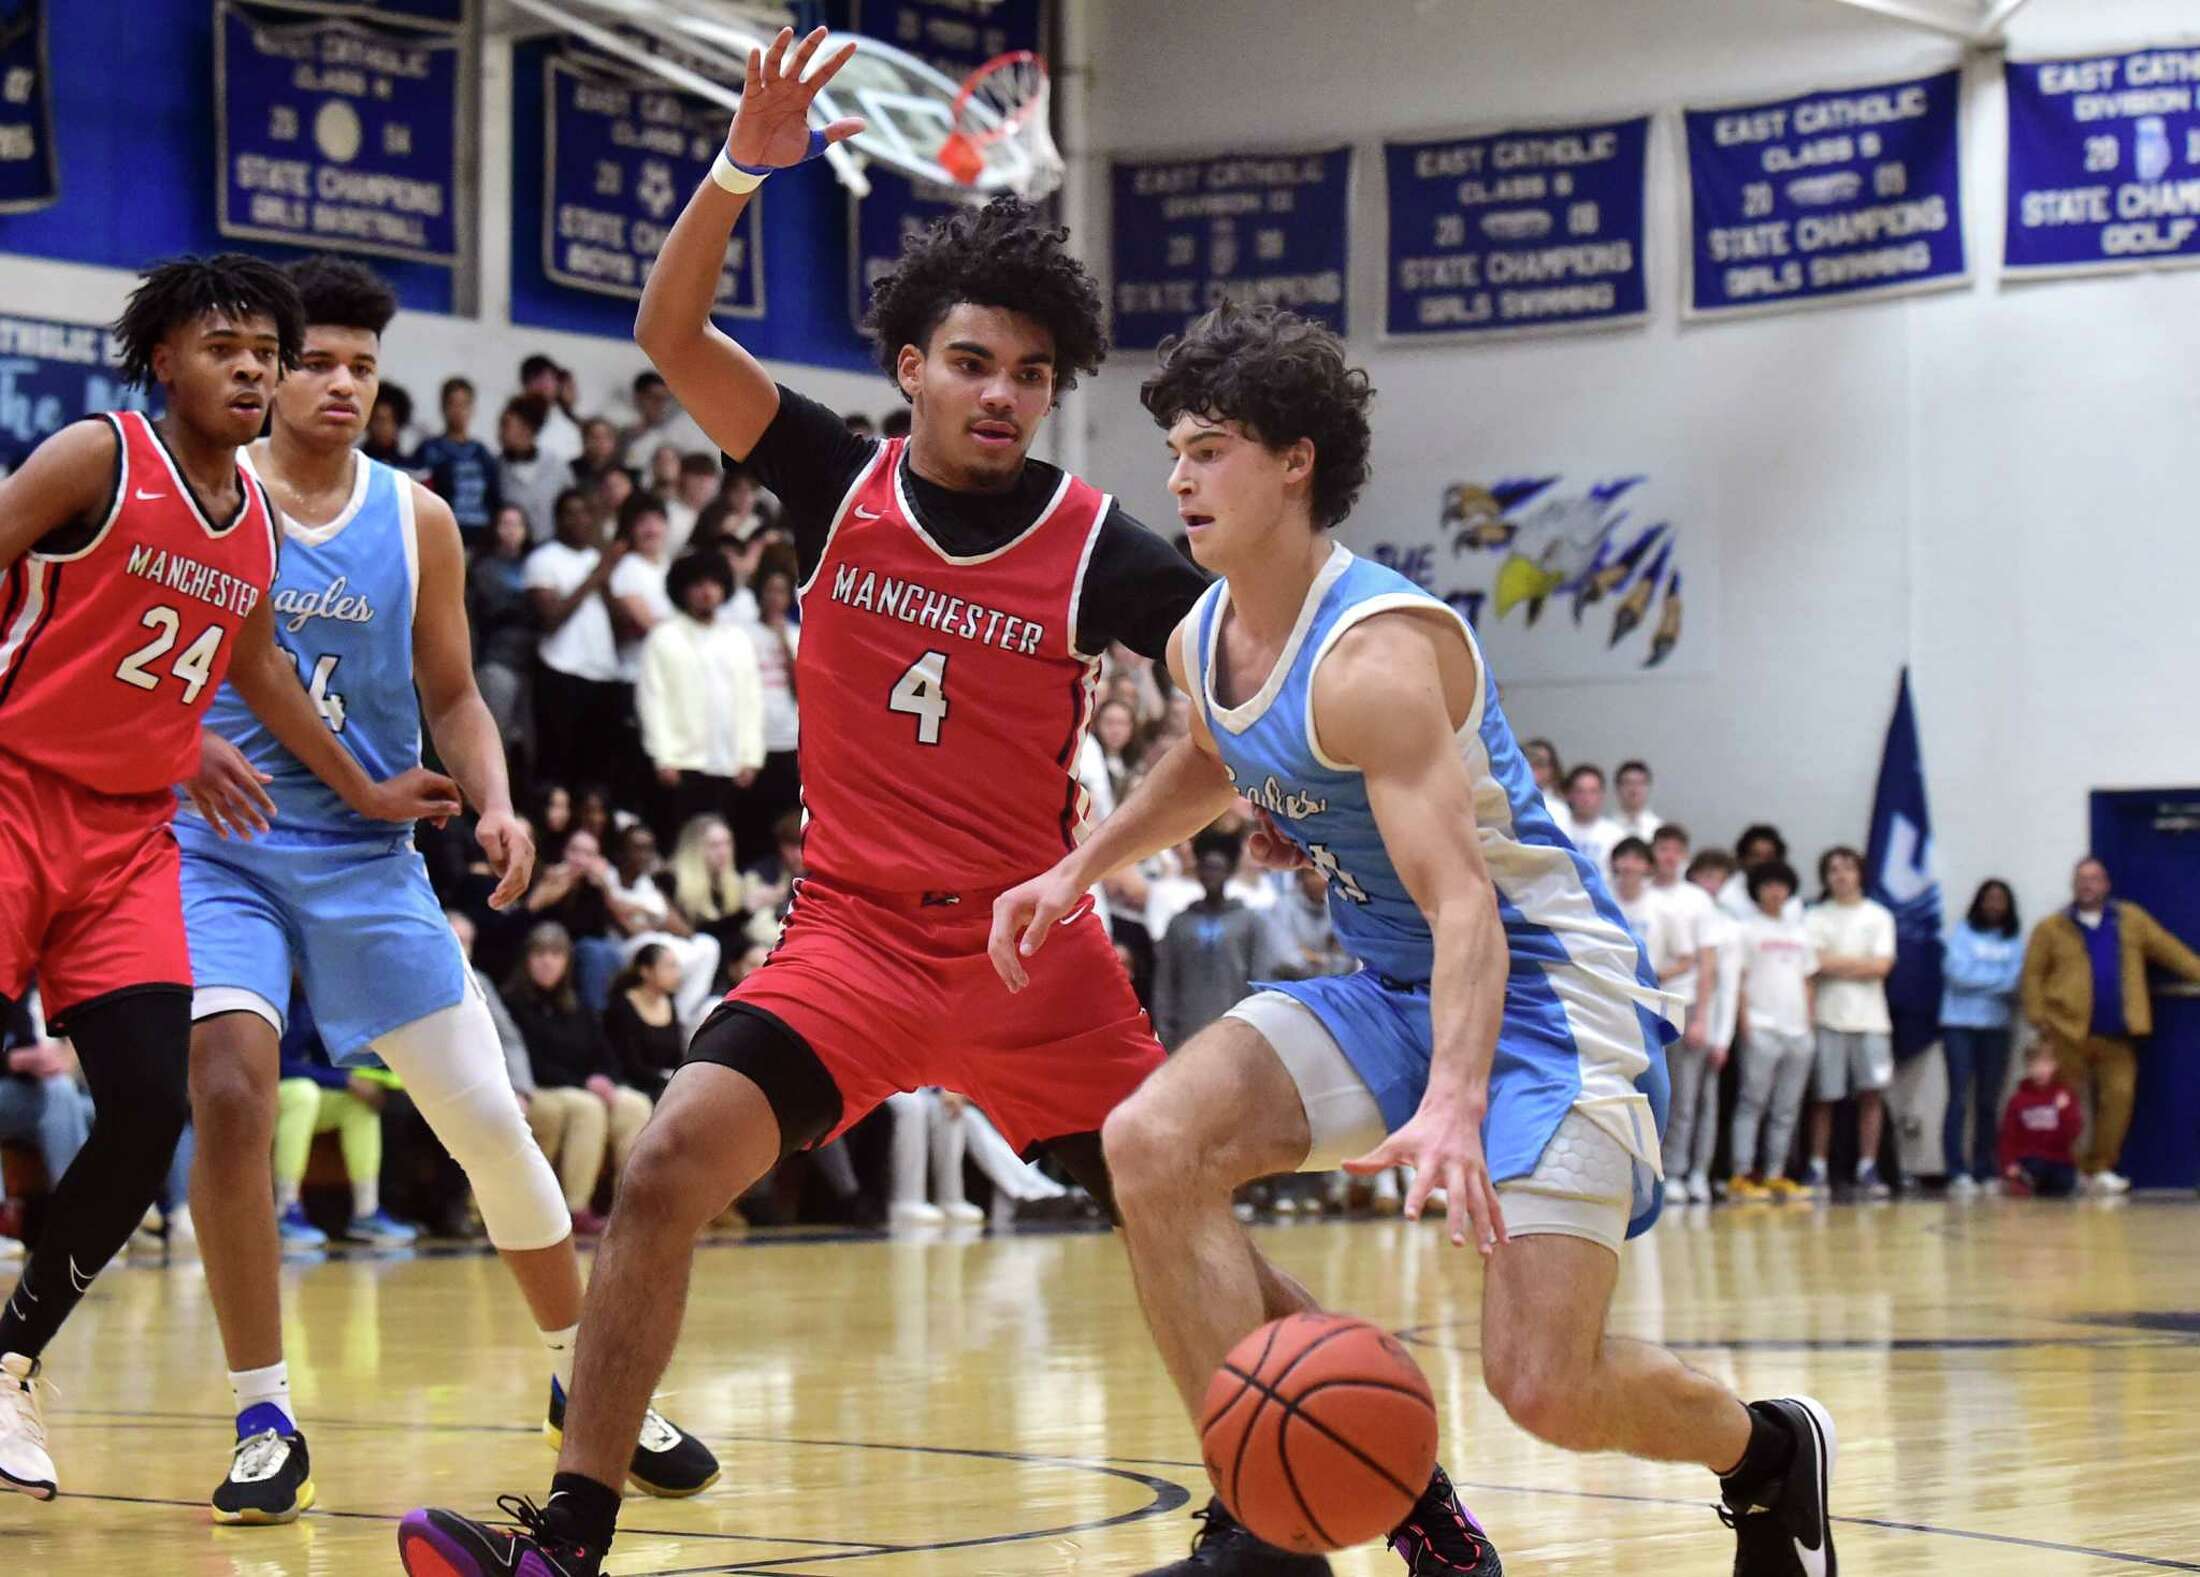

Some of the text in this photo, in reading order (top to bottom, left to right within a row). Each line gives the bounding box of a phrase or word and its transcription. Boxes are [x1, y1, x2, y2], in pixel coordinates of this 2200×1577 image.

[2038, 59, 2119, 95] EAST
[1714, 86, 1927, 147] EAST CATHOLIC
[2073, 86, 2192, 122] DIVISION
[1415, 131, 1617, 179] EAST CATHOLIC
[1762, 135, 1854, 173] CLASS
[1709, 194, 1947, 262] STATE CHAMPIONS
[2021, 185, 2112, 227] STATE
[2101, 218, 2198, 255] GOLF
[1402, 239, 1633, 290] STATE CHAMPIONS
[274, 575, 375, 633] agles
[831, 563, 1045, 656] MANCHESTER
[114, 604, 225, 706] 24
[889, 649, 950, 745] 4
